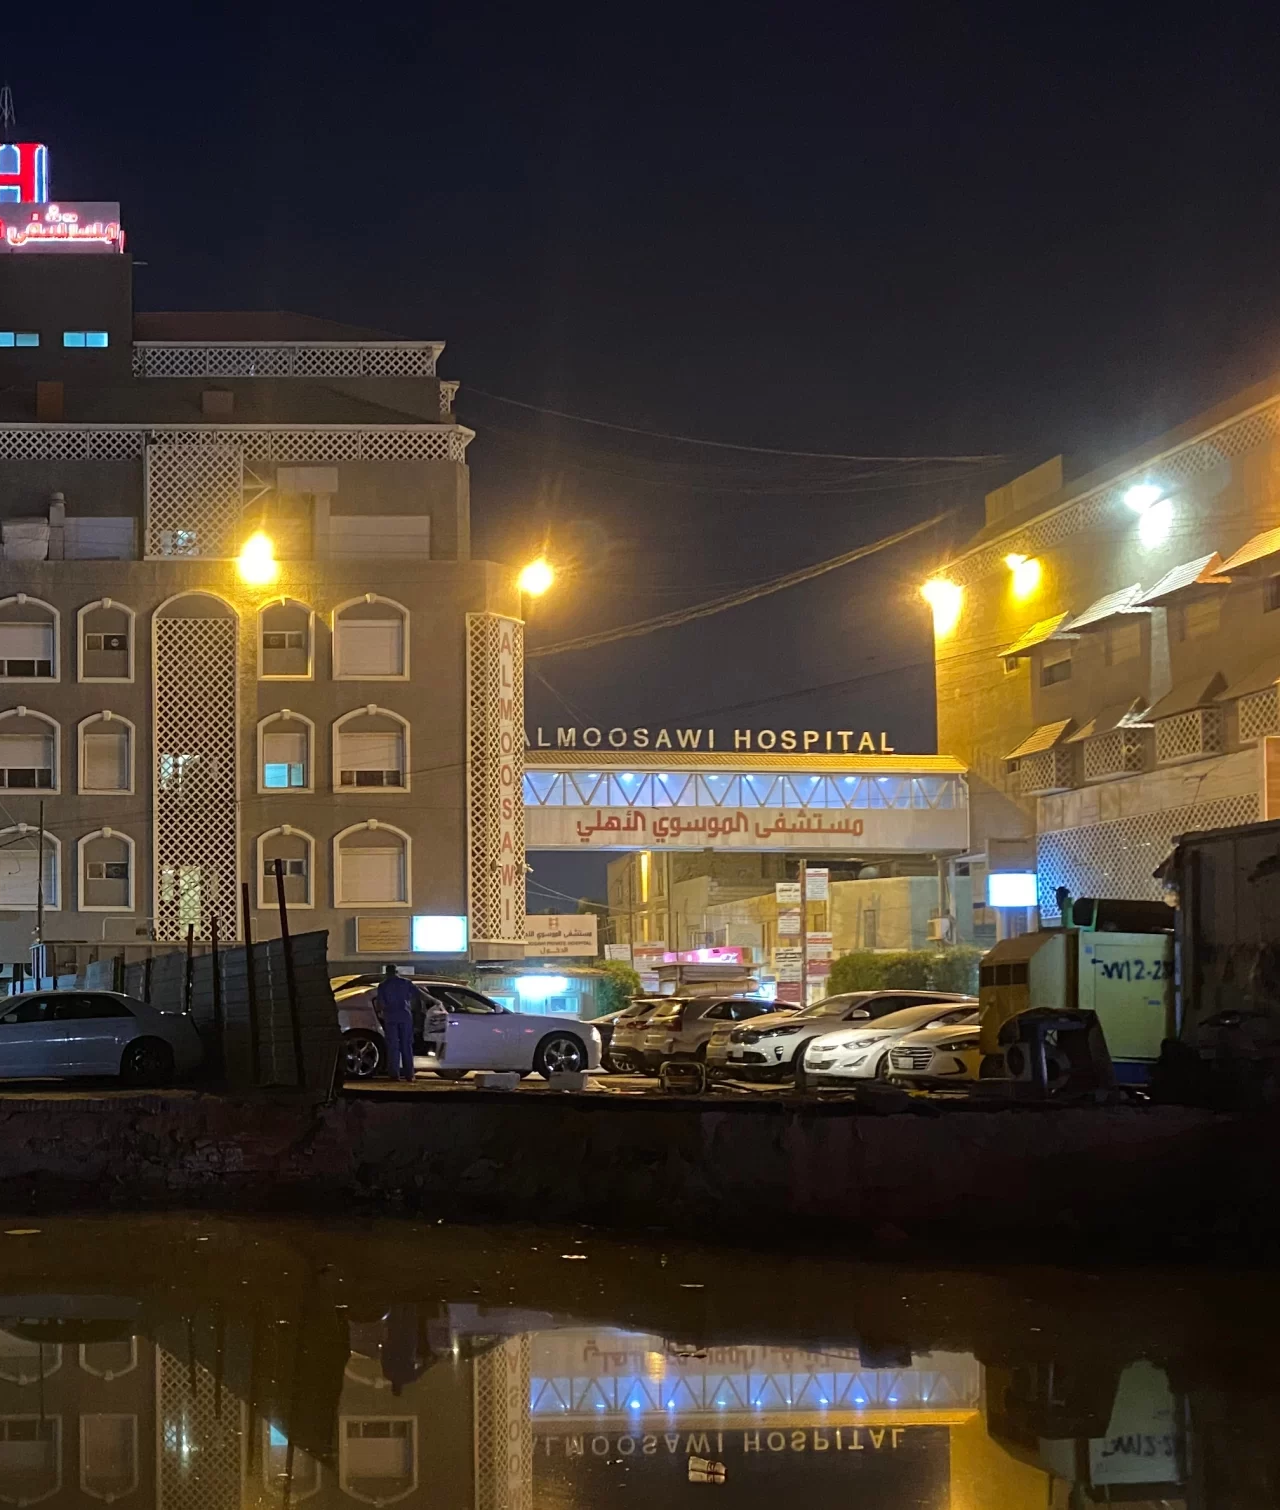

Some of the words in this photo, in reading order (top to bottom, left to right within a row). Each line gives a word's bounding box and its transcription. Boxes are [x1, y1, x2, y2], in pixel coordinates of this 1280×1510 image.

[6, 204, 118, 246] مستشفى
[734, 729, 895, 752] HOSPITAL
[500, 632, 514, 921] ALMOOSAWI
[576, 809, 646, 843] الأهلي
[653, 811, 748, 843] الموسوي
[755, 808, 864, 839] مستشفى
